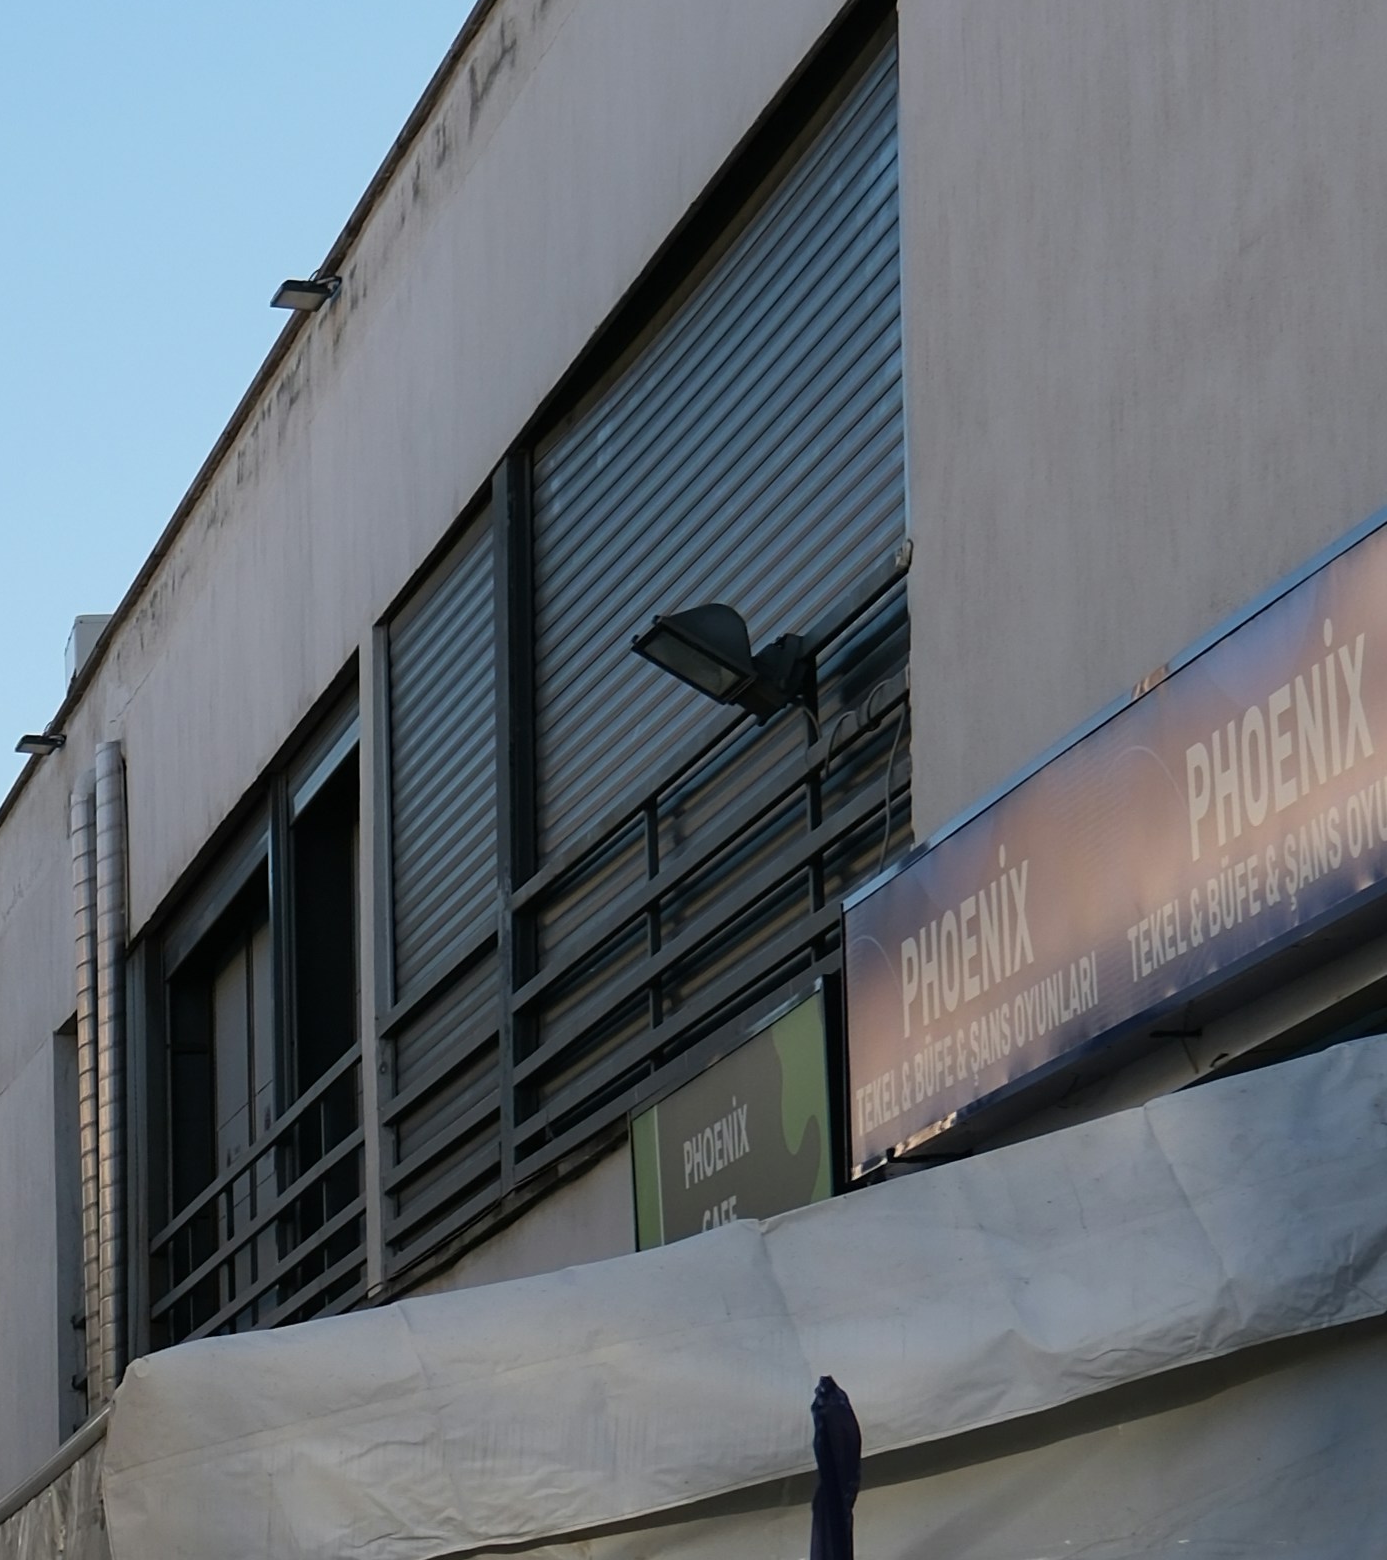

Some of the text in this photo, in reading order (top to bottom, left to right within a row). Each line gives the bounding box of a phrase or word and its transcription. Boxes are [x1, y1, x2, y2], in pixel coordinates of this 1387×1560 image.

[1185, 618, 1374, 862] PHOENİX
[901, 844, 1034, 1039] PHOENİX
[1127, 898, 1187, 983] TEKEL
[1190, 888, 1203, 948] &
[1207, 856, 1261, 938] BÜFE
[1265, 845, 1280, 907] &
[1284, 805, 1342, 911] ŞANS
[855, 950, 1099, 1136] TEKEL & BÜFE & ŞANS OYUNLARI
[683, 1095, 750, 1190] PHOENİX
